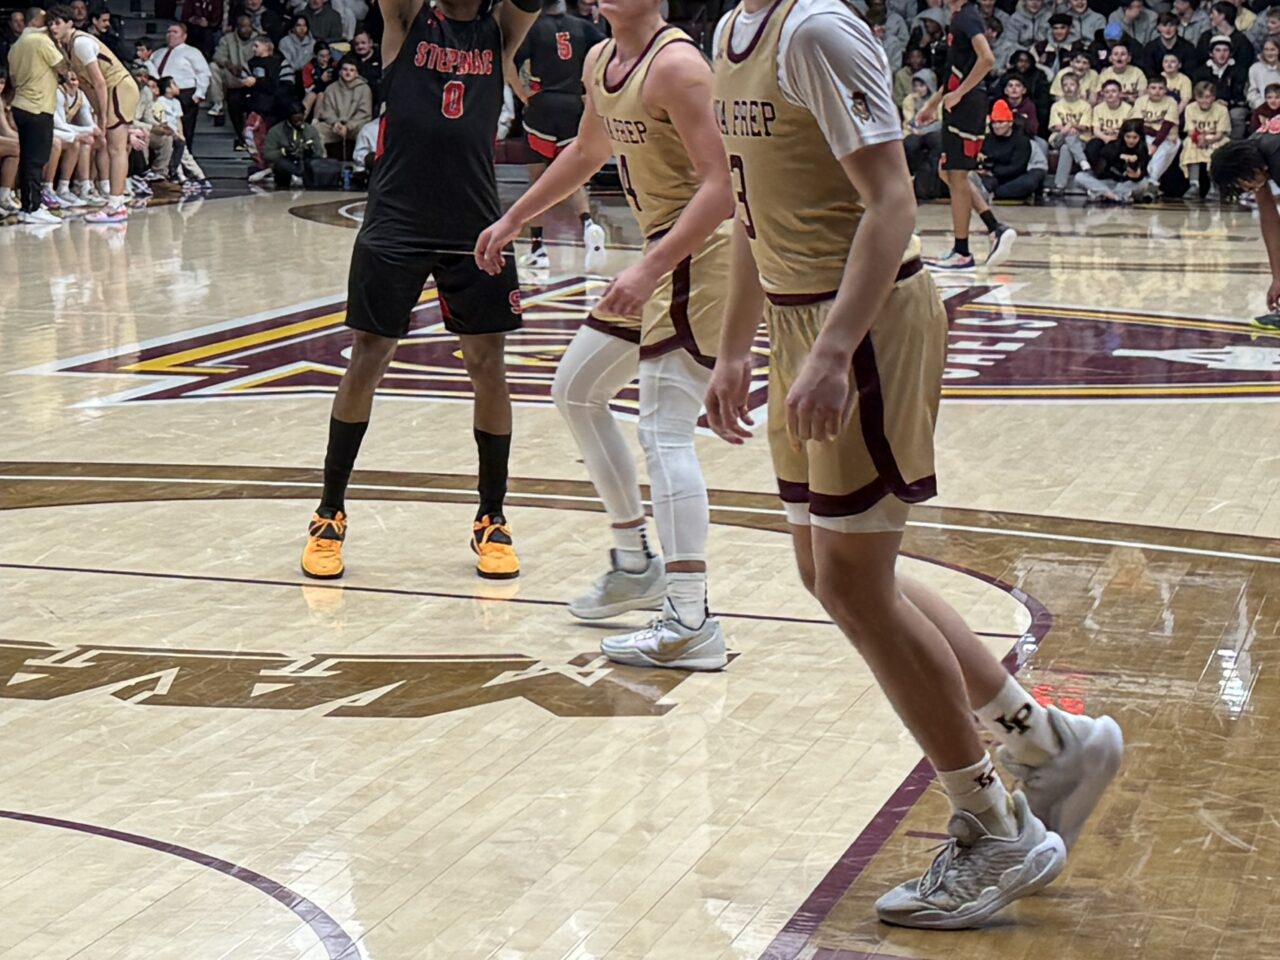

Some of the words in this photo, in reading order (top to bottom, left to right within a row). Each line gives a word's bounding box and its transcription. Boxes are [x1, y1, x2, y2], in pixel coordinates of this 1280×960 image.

[555, 27, 573, 61] 5
[441, 80, 465, 119] 0
[732, 100, 776, 137] PREP
